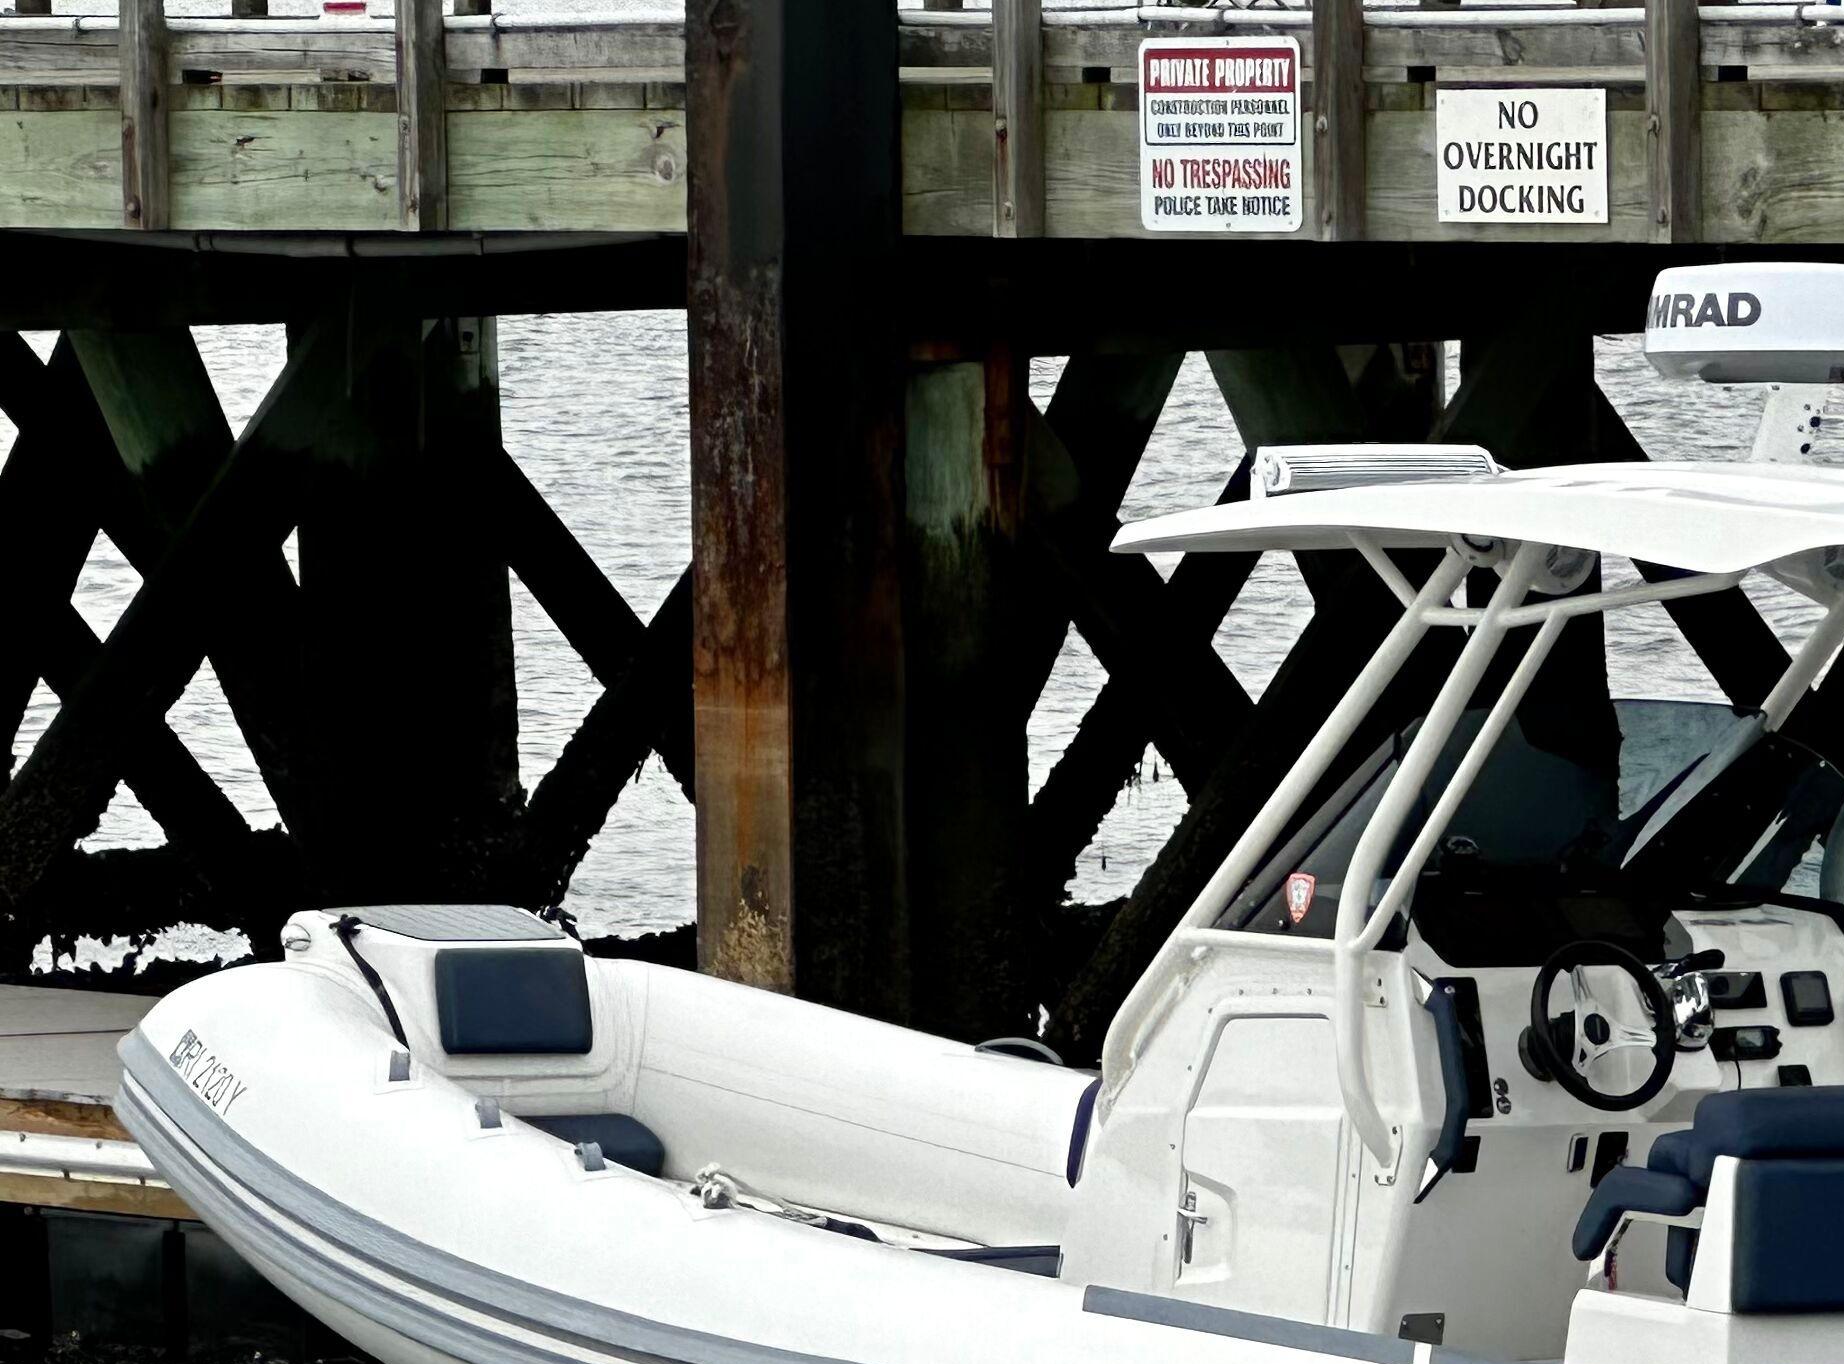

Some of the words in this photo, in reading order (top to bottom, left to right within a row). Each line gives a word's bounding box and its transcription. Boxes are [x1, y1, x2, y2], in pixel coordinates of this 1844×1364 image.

[1150, 58, 1210, 87] PRIVATE
[1214, 58, 1290, 87] PROPERTY
[1151, 99, 1227, 115] CONSTRUCTION
[1231, 99, 1290, 115] PERSONNEL
[1498, 100, 1538, 129] NO
[1157, 122, 1181, 138] ONLY
[1185, 122, 1225, 138] BEYOND
[1228, 122, 1250, 138] THIS
[1253, 122, 1284, 138] POINT
[1443, 142, 1598, 170] OVERNIGHT
[1152, 158, 1175, 189] NO
[1180, 158, 1291, 189] TRESPASSING
[1154, 196, 1203, 216] POLICE
[1205, 196, 1238, 216] TAKE
[1242, 196, 1291, 216] NOTICE
[1458, 185, 1584, 214] DOCKING
[1647, 292, 1762, 329] MRAD
